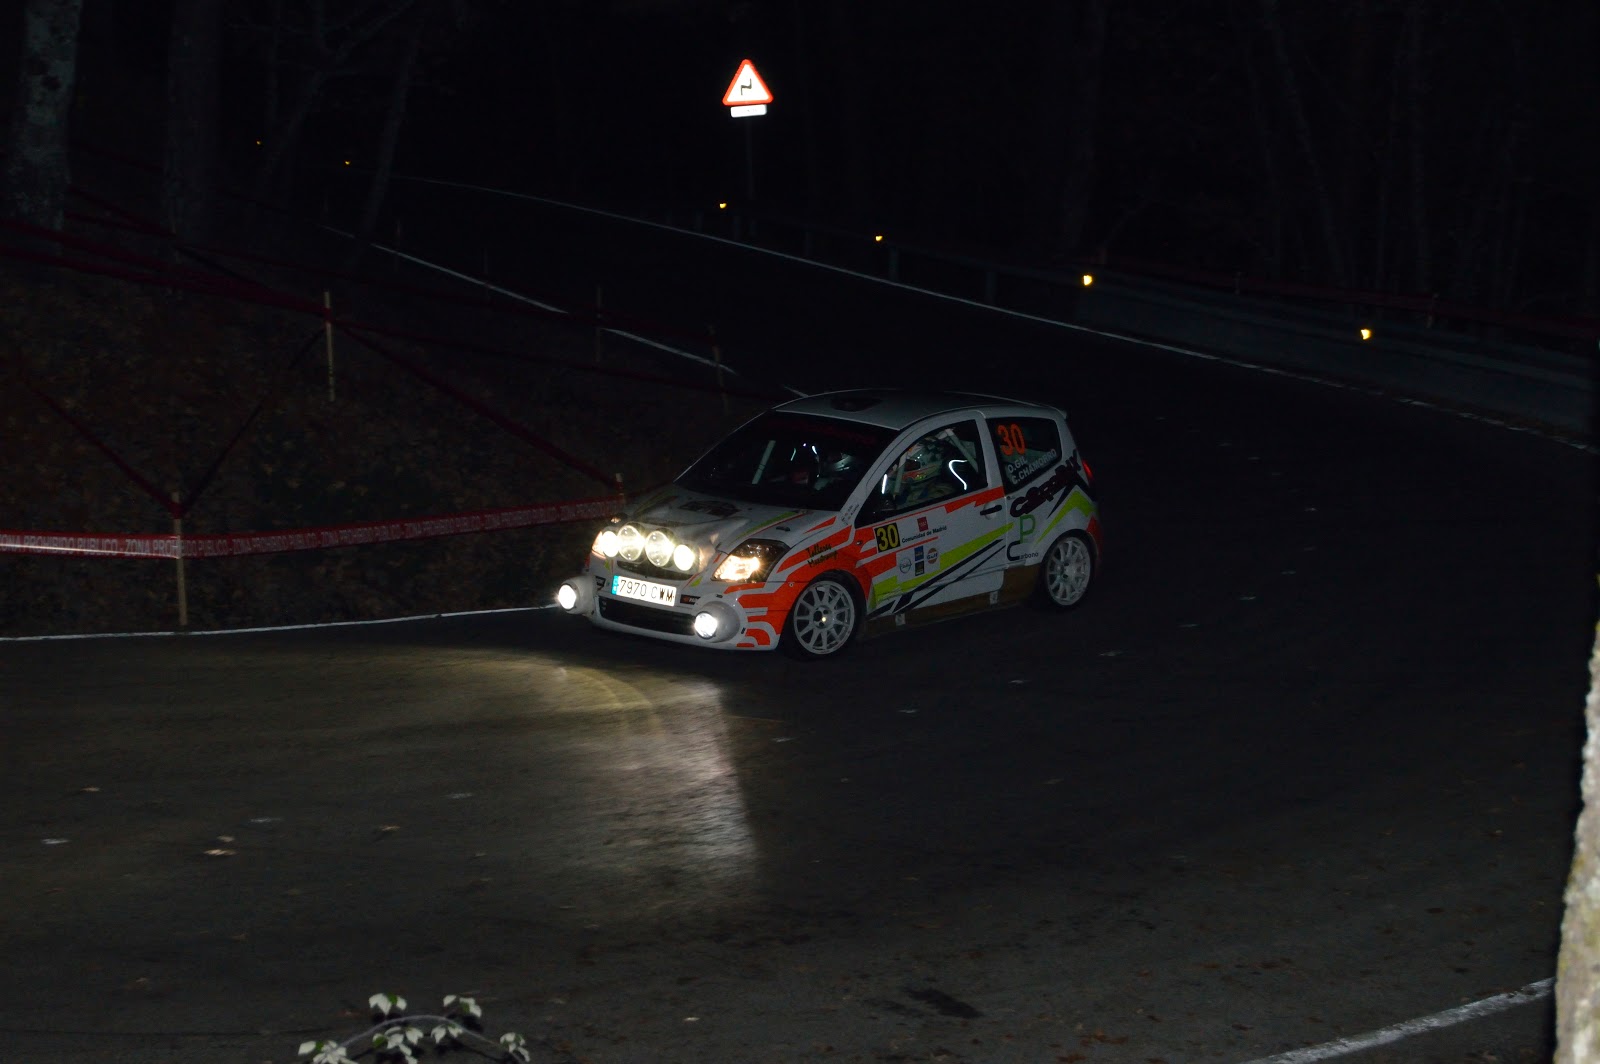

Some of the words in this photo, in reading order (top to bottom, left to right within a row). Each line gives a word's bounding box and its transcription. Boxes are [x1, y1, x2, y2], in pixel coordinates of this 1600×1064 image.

[996, 422, 1026, 456] 30
[1007, 456, 1028, 473] O.GIL
[1011, 448, 1057, 485] C.CHAMORRO
[876, 523, 899, 552] 30
[902, 532, 925, 543] Comunidad
[932, 526, 947, 534] Madrid
[77, 537, 118, 556] PUBLICO
[125, 539, 150, 557] ZONA
[926, 552, 938, 560] Gulf
[620, 580, 647, 597] 7970
[651, 586, 673, 602] CWM
